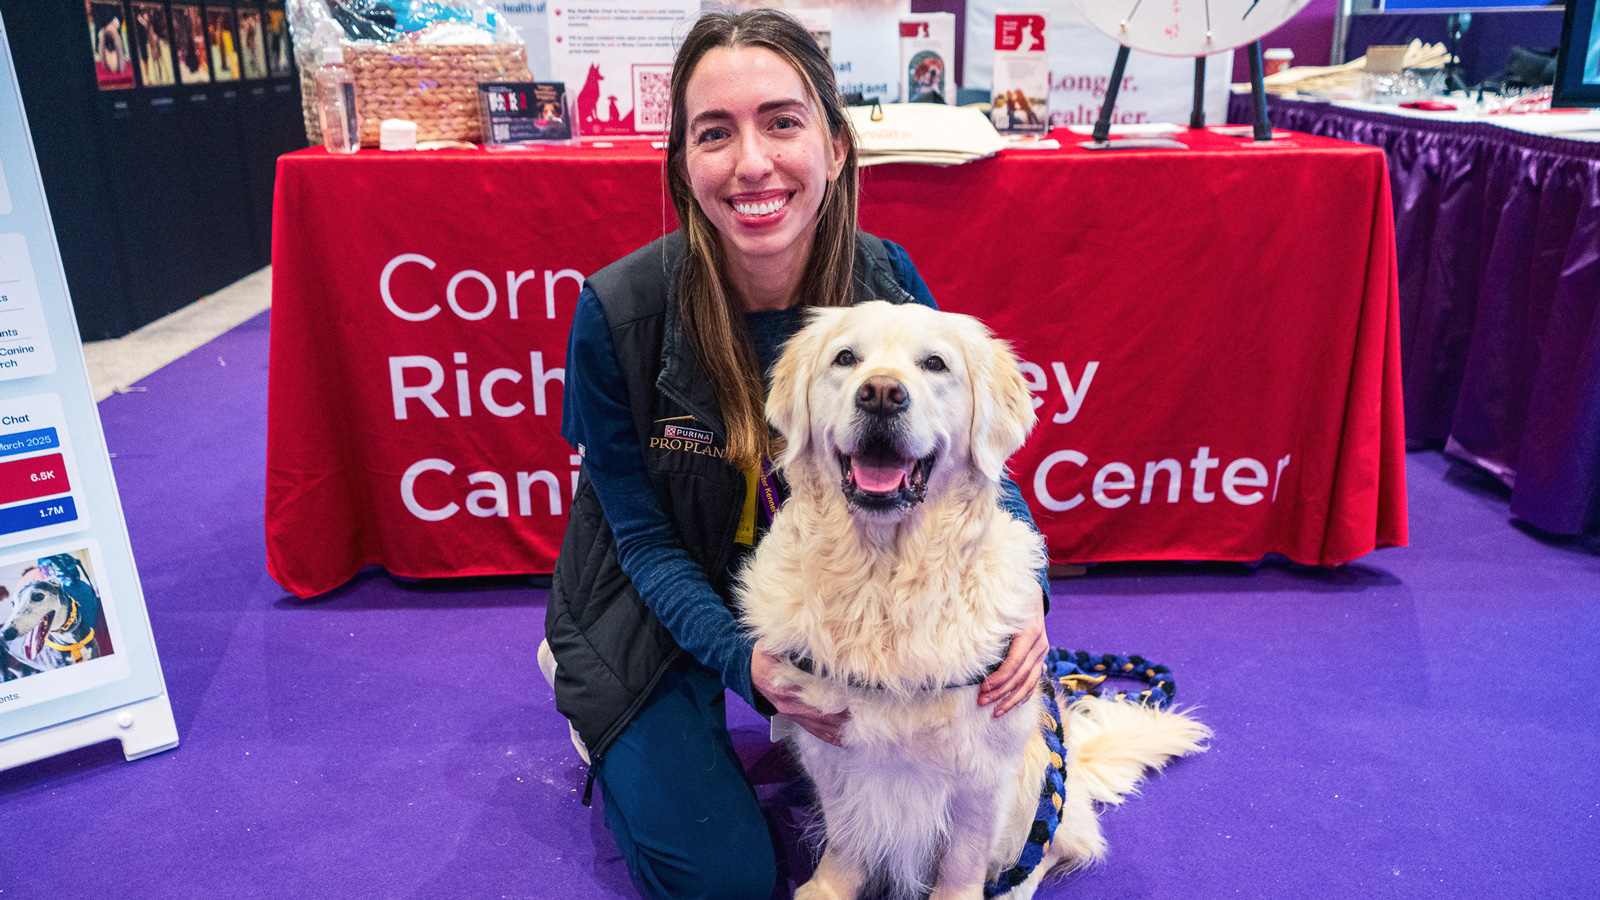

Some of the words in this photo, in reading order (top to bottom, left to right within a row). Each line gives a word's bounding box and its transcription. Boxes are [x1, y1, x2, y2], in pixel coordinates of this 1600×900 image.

[1047, 71, 1138, 98] Longr.
[380, 253, 586, 322] Corn
[0, 345, 35, 357] Canine
[0, 359, 18, 369] rch
[388, 350, 566, 421] Rich
[1018, 360, 1100, 424] ey
[2, 414, 30, 426] Chat
[26, 435, 52, 447] 2025
[676, 428, 710, 441] PURINA
[650, 437, 682, 450] PRO
[684, 440, 726, 459] PLAN
[30, 470, 56, 482] 6.5K
[400, 454, 582, 522] Cani
[1033, 446, 1291, 512] Center
[764, 487, 778, 513] Kennel
[39, 505, 65, 518] 1.7M
